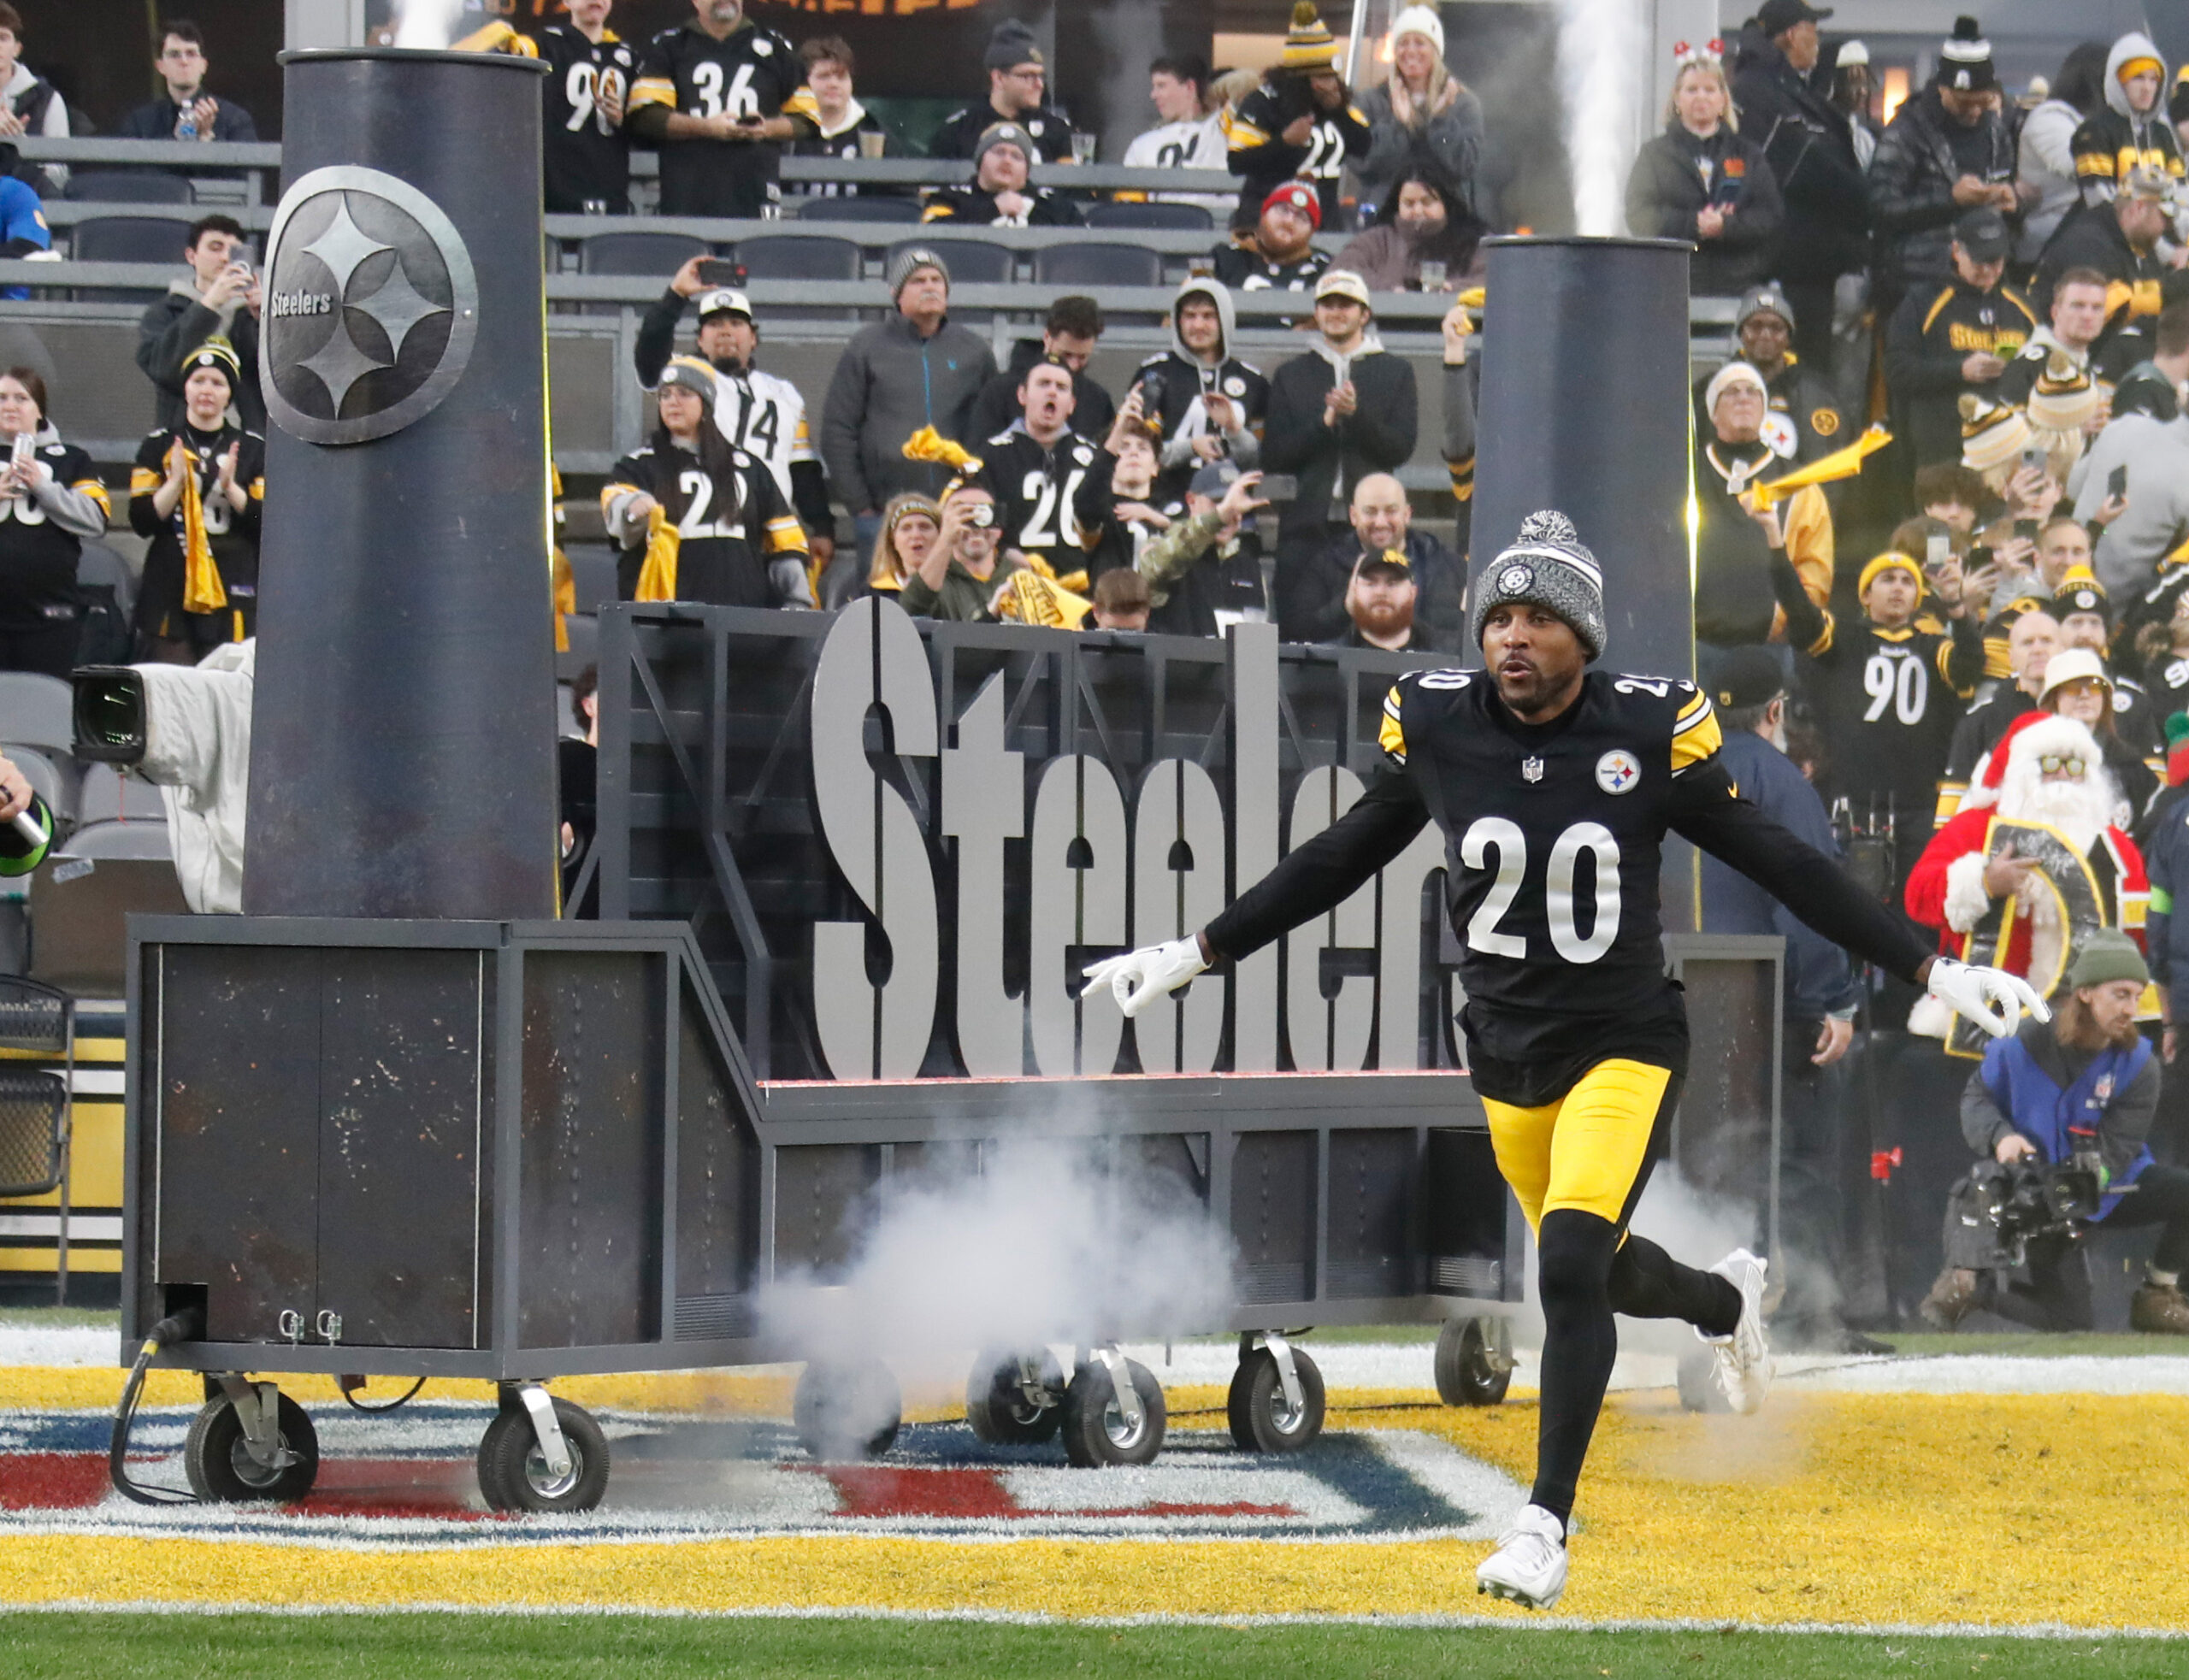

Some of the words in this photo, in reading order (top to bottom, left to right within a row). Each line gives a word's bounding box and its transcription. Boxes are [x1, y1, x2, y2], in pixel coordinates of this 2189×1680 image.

[565, 62, 627, 137] 90
[689, 61, 759, 120] 36
[1297, 121, 1342, 179] 22
[271, 288, 331, 317] Steelers
[735, 391, 778, 461] 14
[1863, 655, 1928, 726] 90
[811, 596, 1472, 1080] Steeler
[1461, 816, 1621, 964] 20
